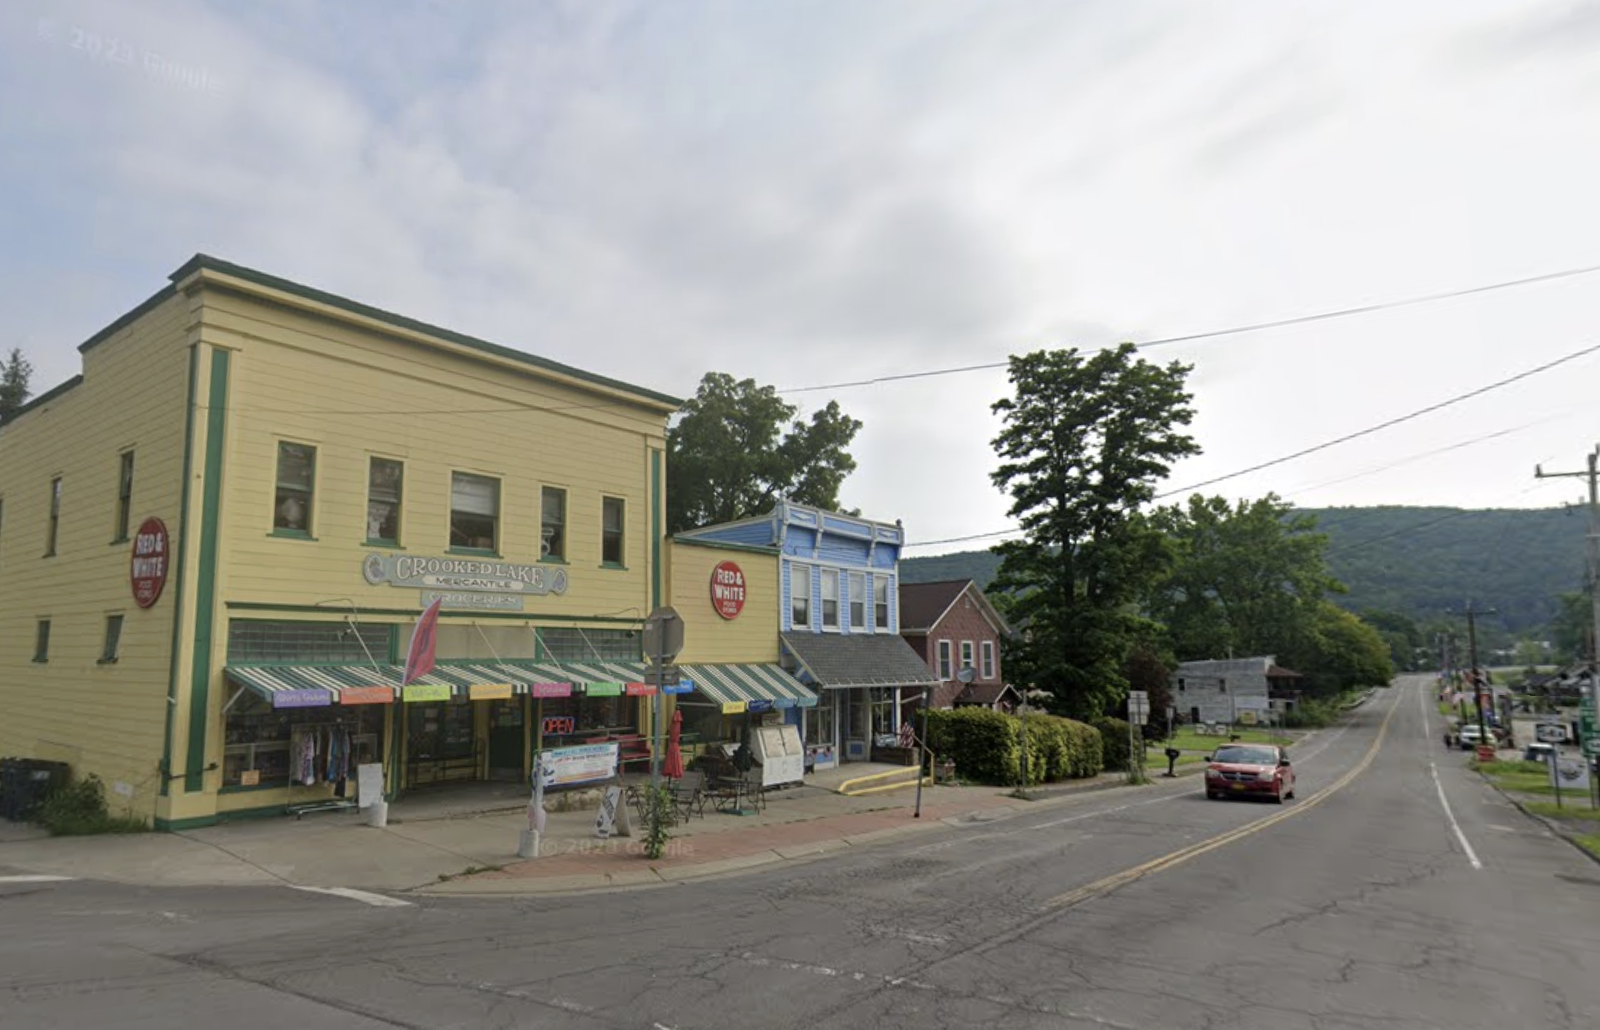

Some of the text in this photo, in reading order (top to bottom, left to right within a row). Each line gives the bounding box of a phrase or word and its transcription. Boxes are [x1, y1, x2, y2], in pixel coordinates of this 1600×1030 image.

[137, 534, 155, 554] RED
[133, 556, 163, 579] WHITE
[396, 556, 544, 589] CROOKED LAKE
[436, 577, 511, 588] MERCANTILE
[717, 568, 735, 584] RED
[714, 585, 744, 600] WHITE
[543, 718, 573, 734] OPEN
